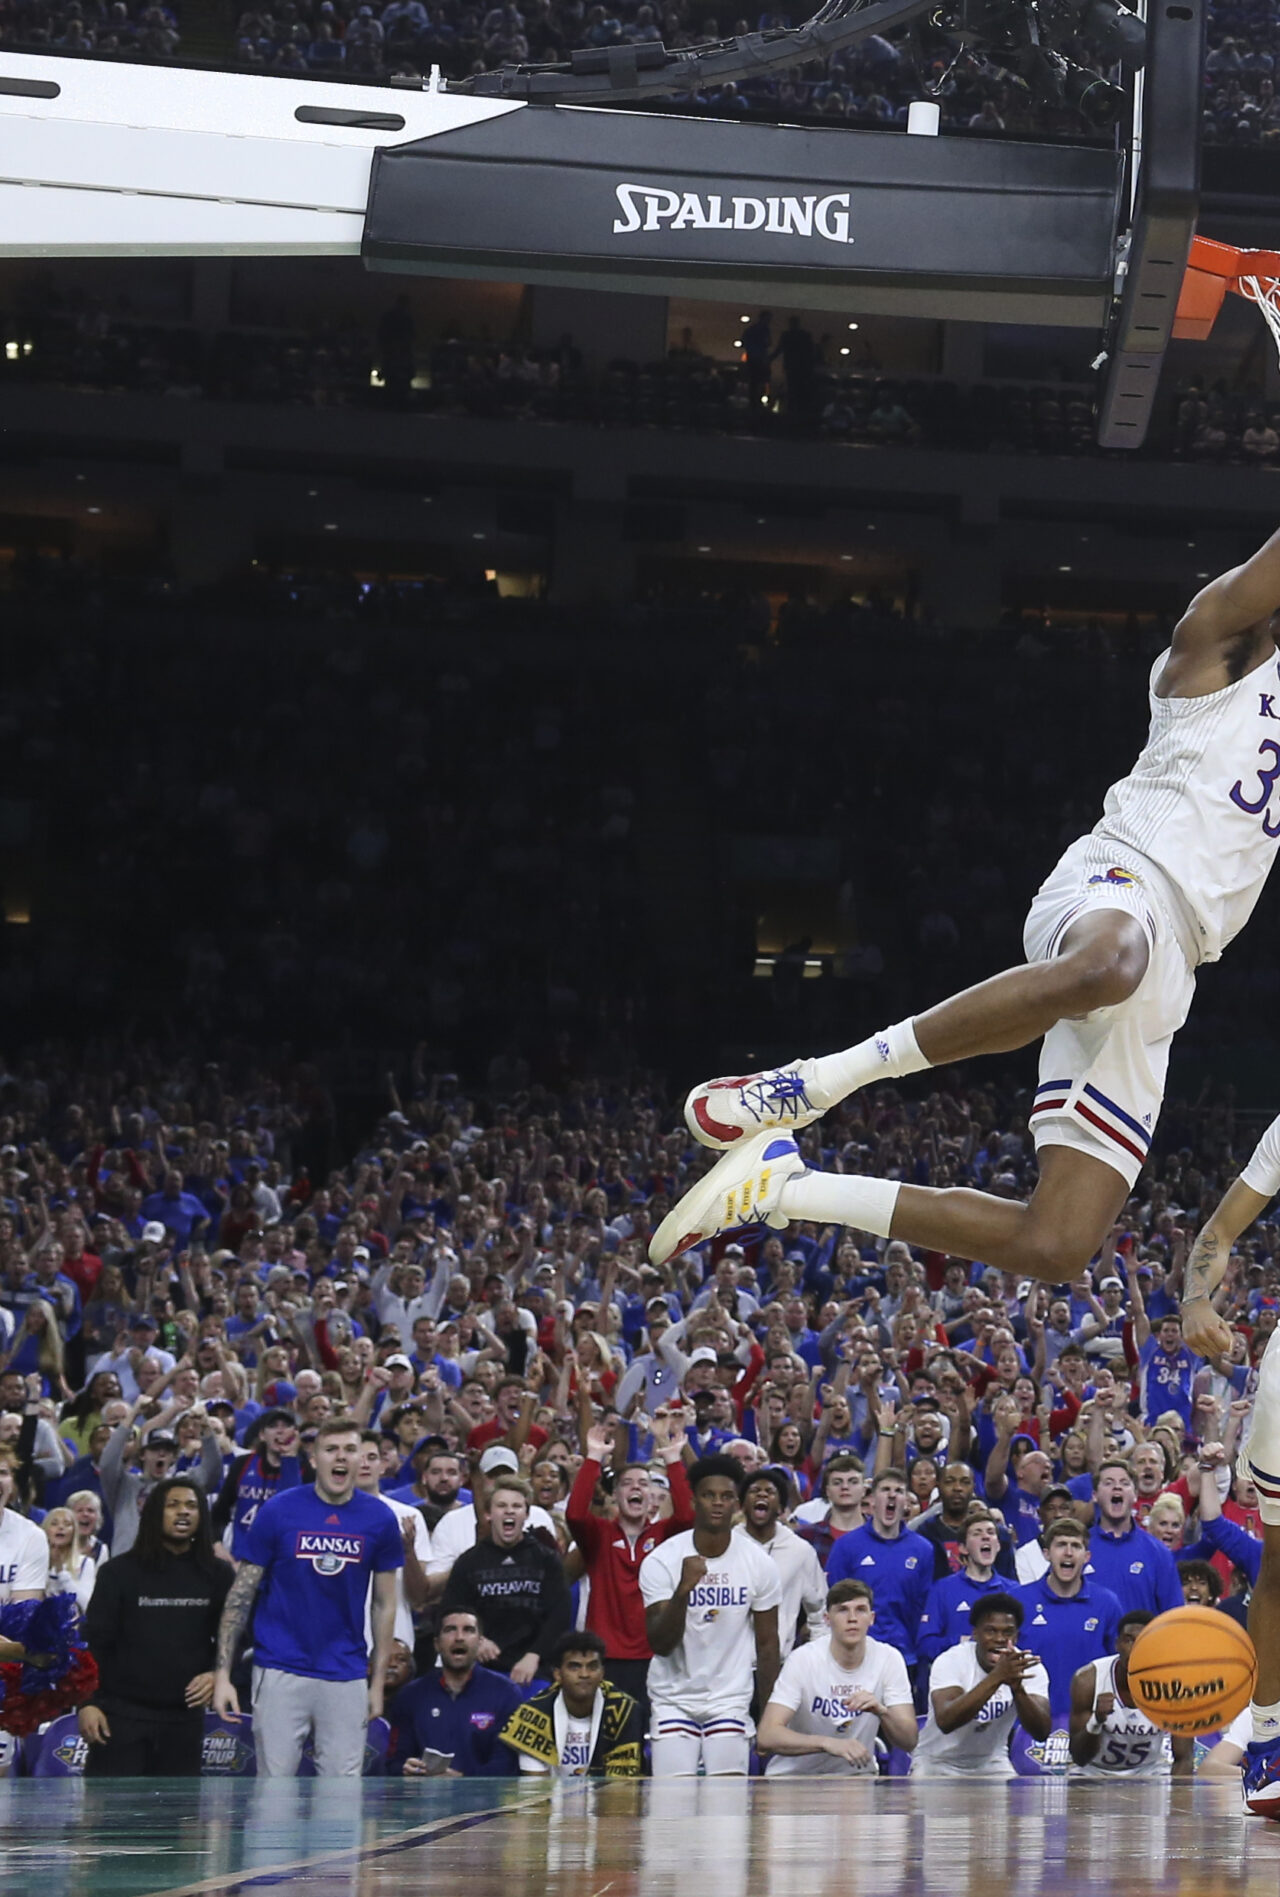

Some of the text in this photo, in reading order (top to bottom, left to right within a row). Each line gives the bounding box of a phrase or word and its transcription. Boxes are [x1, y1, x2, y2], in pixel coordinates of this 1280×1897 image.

[613, 183, 850, 243] SPALDING
[300, 1536, 361, 1554] KANSAS
[688, 1586, 748, 1607] OSSIBLE
[1139, 1677, 1224, 1701] Wilson
[812, 1696, 863, 1718] POSS
[512, 1723, 553, 1756] HERE
[1102, 1724, 1160, 1736] ANSA
[203, 1737, 237, 1750] FINAL
[1101, 1740, 1152, 1766] 55
[1044, 1750, 1072, 1763] FOU
